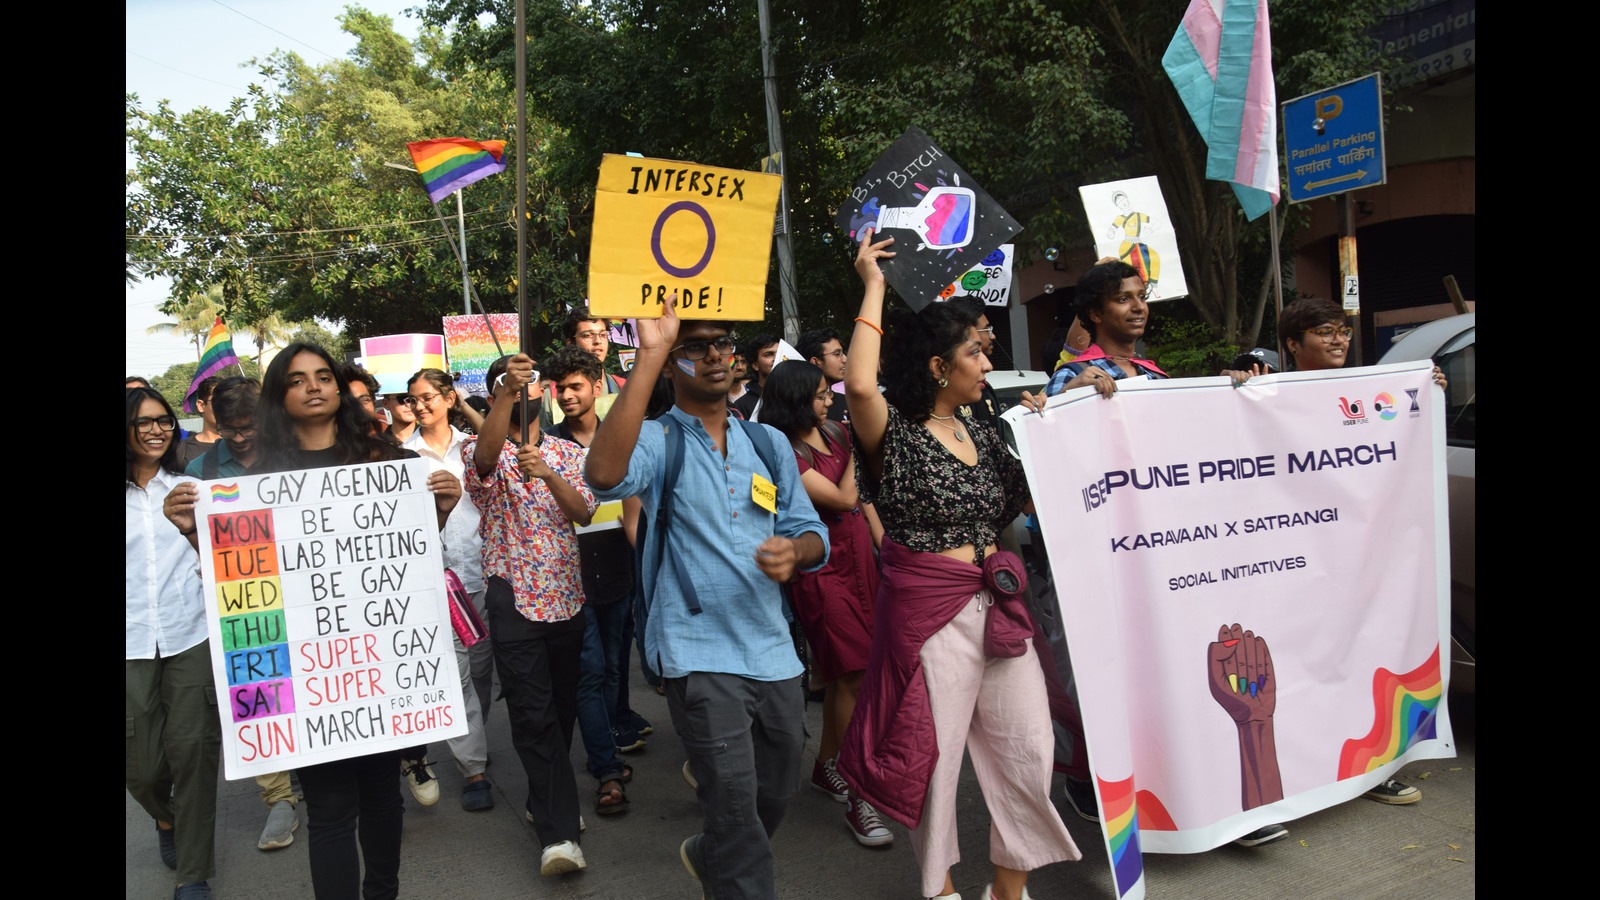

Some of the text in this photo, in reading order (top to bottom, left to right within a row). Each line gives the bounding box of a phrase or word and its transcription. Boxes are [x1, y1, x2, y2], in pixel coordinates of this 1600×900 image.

[1291, 131, 1376, 160] Parallel Parking
[1293, 158, 1332, 176] समांतर
[627, 166, 746, 201] INTERSEX
[852, 145, 943, 203] BI, BITCH
[982, 267, 1003, 279] BE
[1356, 417, 1370, 425] PUNE
[257, 463, 413, 505] GAY AGENDA
[1081, 440, 1397, 513] IISE PUNE PRIDE MARCH
[212, 499, 398, 545] MON BE GAY
[1111, 507, 1339, 553] KARAVAAN X SATRANGI
[217, 528, 427, 578] TUE LAB MEETING
[1168, 555, 1307, 591] SOCIAL INITIATIVES
[221, 562, 408, 612] WED BE GAY
[225, 595, 411, 648] THU BE GAY
[230, 625, 438, 683] FRI SUPER GAY
[235, 657, 441, 719] SAT SUPER GAY
[238, 689, 446, 762] SUN MARCH FOR OUR
[391, 705, 454, 737] RIGHTS
